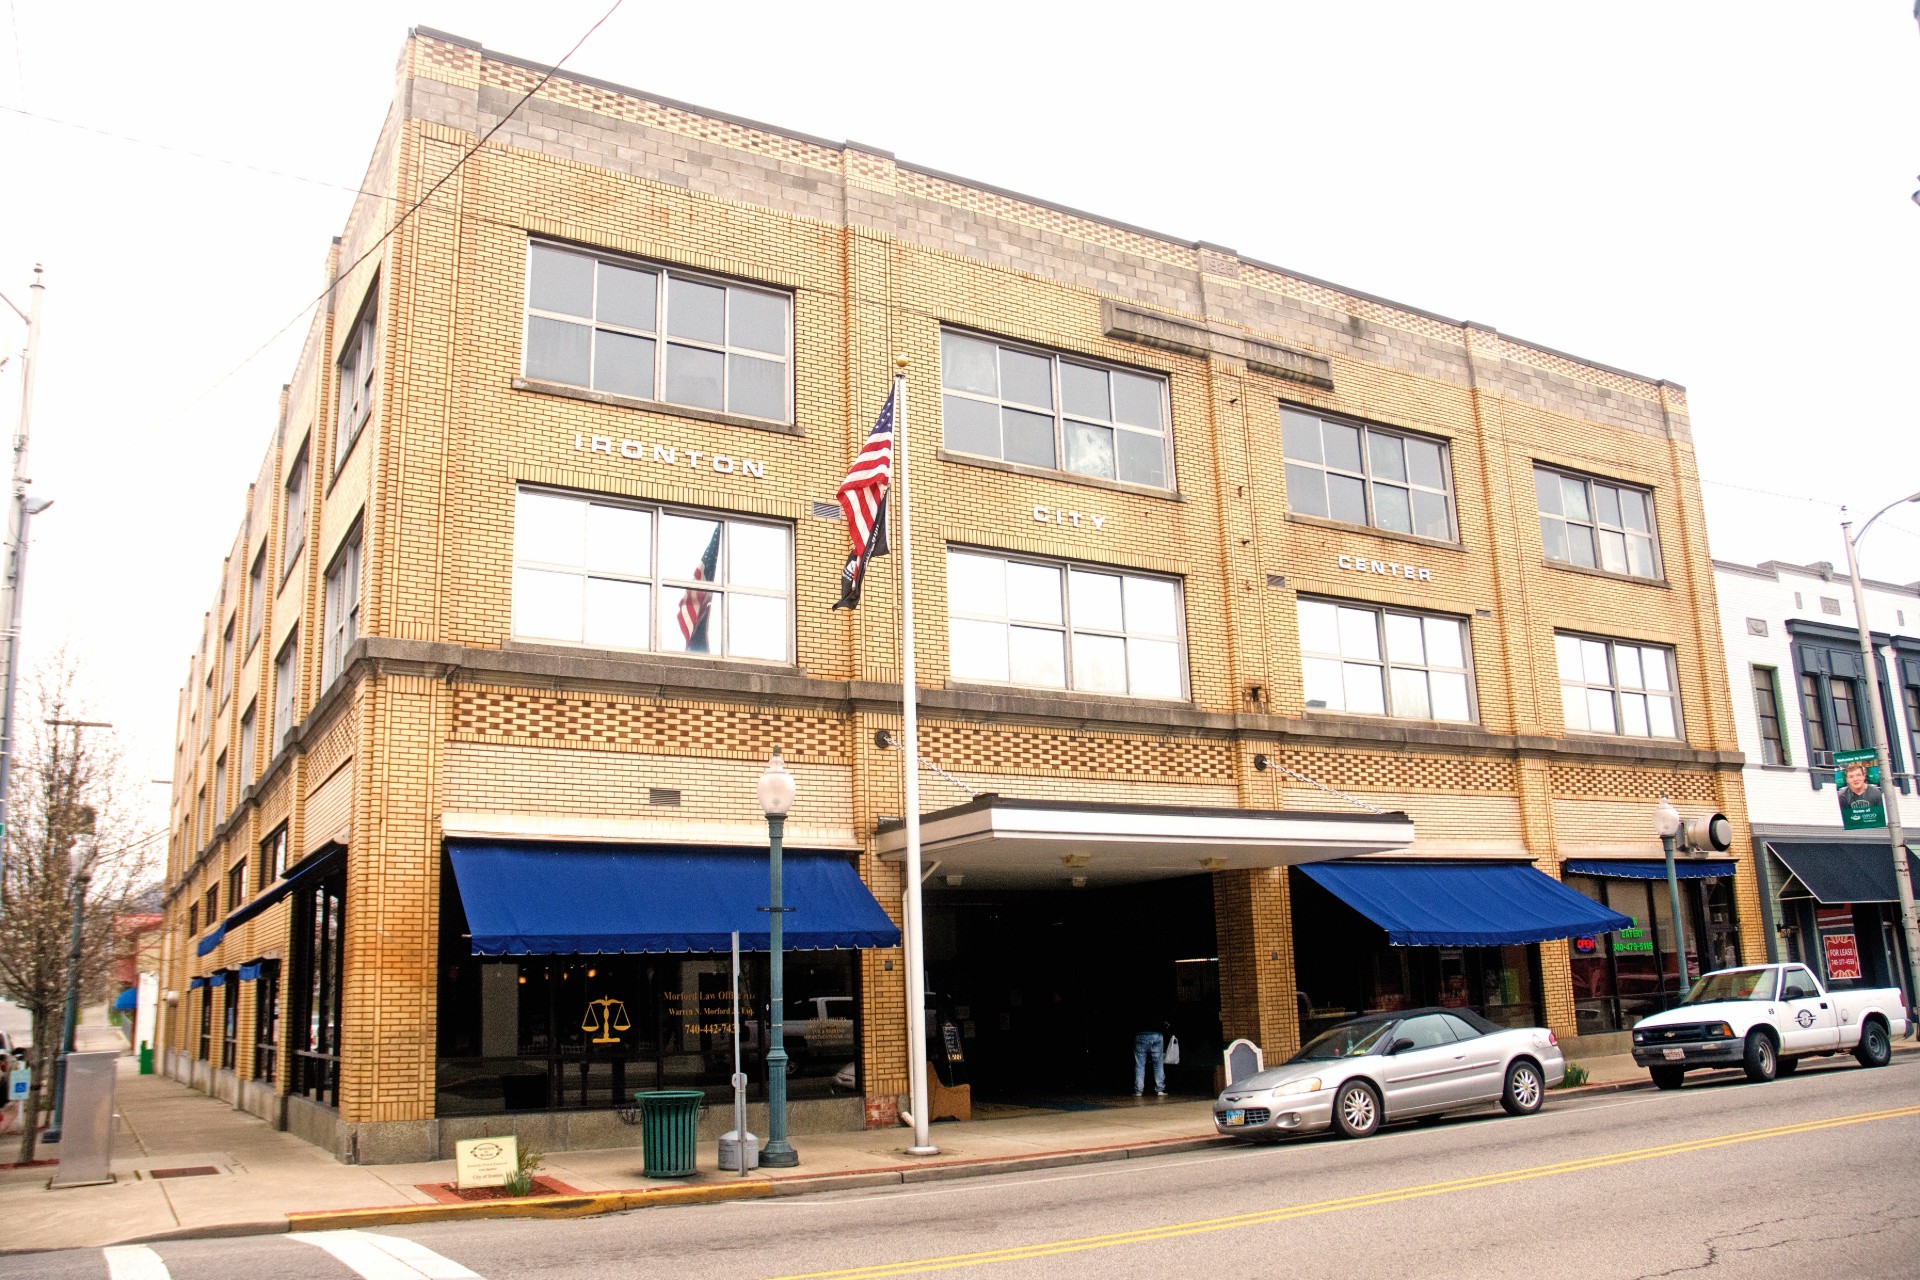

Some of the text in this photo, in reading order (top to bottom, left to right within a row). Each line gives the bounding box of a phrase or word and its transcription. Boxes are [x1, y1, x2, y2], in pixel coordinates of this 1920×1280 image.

[575, 434, 764, 478] IRONTON
[1033, 505, 1106, 531] CITY
[1338, 554, 1431, 582] CENTER
[1621, 929, 1643, 938] EATERY
[1577, 938, 1595, 949] OPEN
[1840, 948, 1853, 956] LEASE
[663, 991, 697, 1001] Morford
[699, 991, 716, 1000] Law
[718, 991, 741, 1000] Offi
[668, 1007, 693, 1016] Warren
[703, 1007, 730, 1015] Morford
[741, 1006, 755, 1017] Esq.
[685, 1023, 740, 1034] 740-442-743
